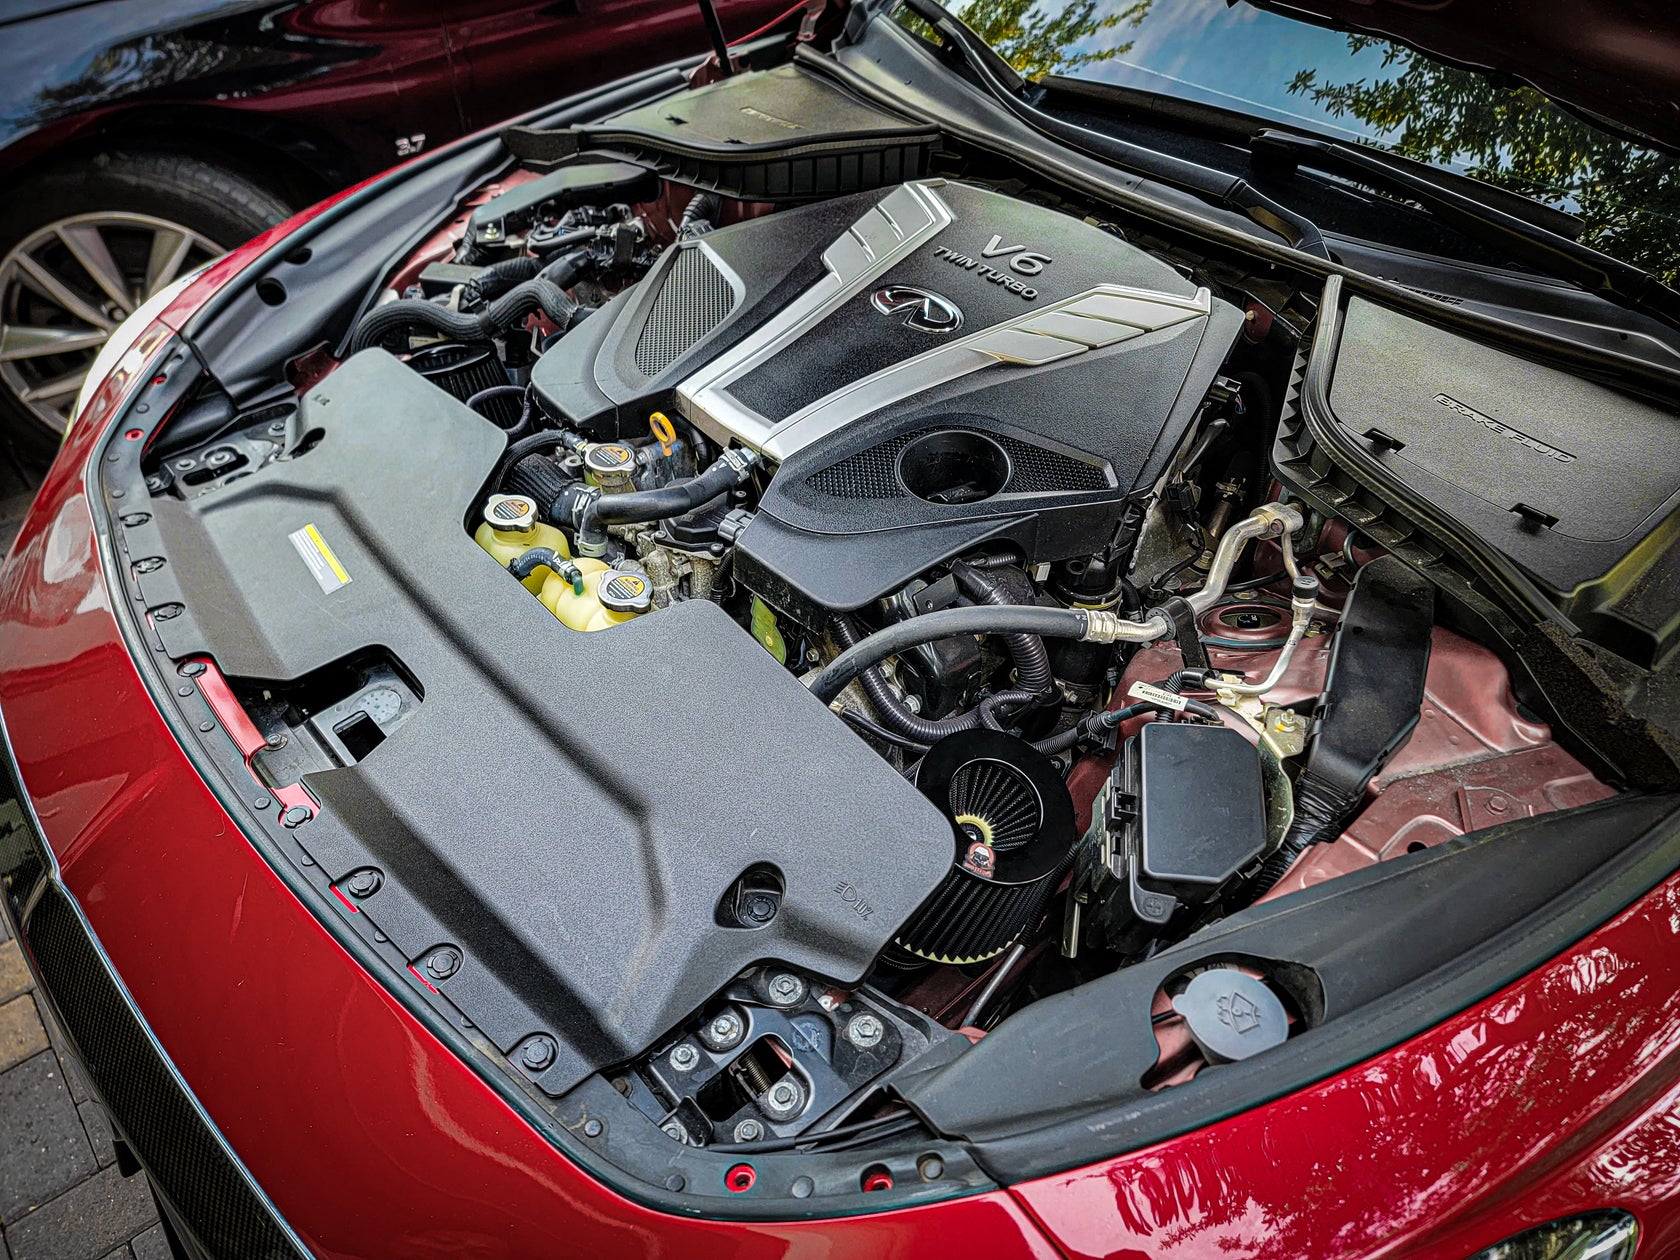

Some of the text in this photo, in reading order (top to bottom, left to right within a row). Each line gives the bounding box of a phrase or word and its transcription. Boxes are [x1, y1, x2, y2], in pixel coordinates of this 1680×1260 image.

[395, 134, 426, 156] 3.7
[933, 245, 1038, 300] TWIN TURBO
[981, 234, 1053, 277] V6
[1436, 397, 1574, 463] BRAKE FLUID
